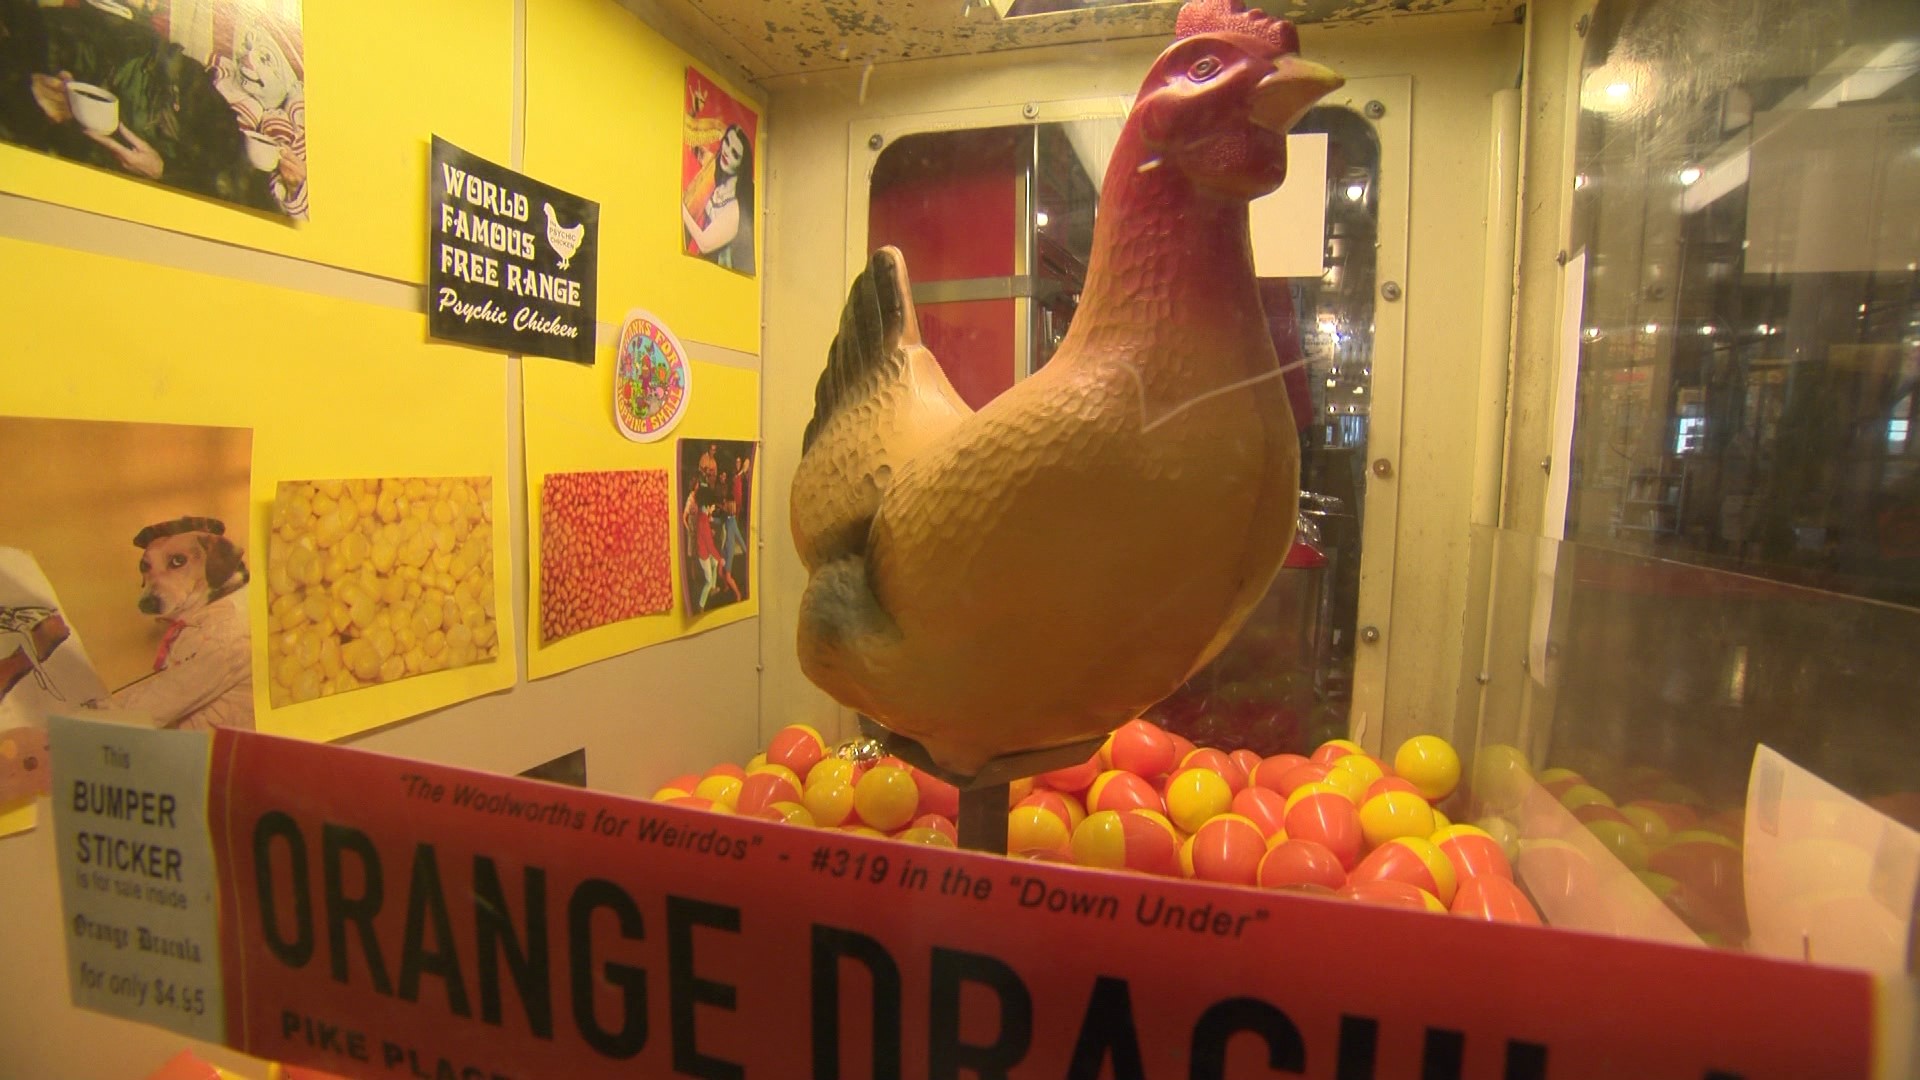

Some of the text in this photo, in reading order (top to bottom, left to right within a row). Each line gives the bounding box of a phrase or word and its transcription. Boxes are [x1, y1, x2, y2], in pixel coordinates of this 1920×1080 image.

[442, 162, 529, 222] WORLD
[441, 203, 536, 260] FAMOUS
[550, 227, 576, 242] PSYCHIC
[441, 244, 581, 307] FREE RANGE
[439, 287, 578, 339] Psychic Chicken
[653, 329, 678, 367] FOR
[650, 387, 683, 427] SMALL
[102, 745, 130, 769] This
[73, 780, 176, 828] BUMPER
[77, 831, 182, 883] STICKER
[454, 783, 585, 830] Woolworths
[592, 809, 629, 837] for
[811, 846, 889, 884] #319
[900, 858, 928, 892] in
[941, 867, 992, 899] the
[252, 810, 745, 1080] ORANGE
[81, 961, 104, 989] for
[110, 972, 148, 1007] only
[281, 1009, 368, 1062] PIKE
